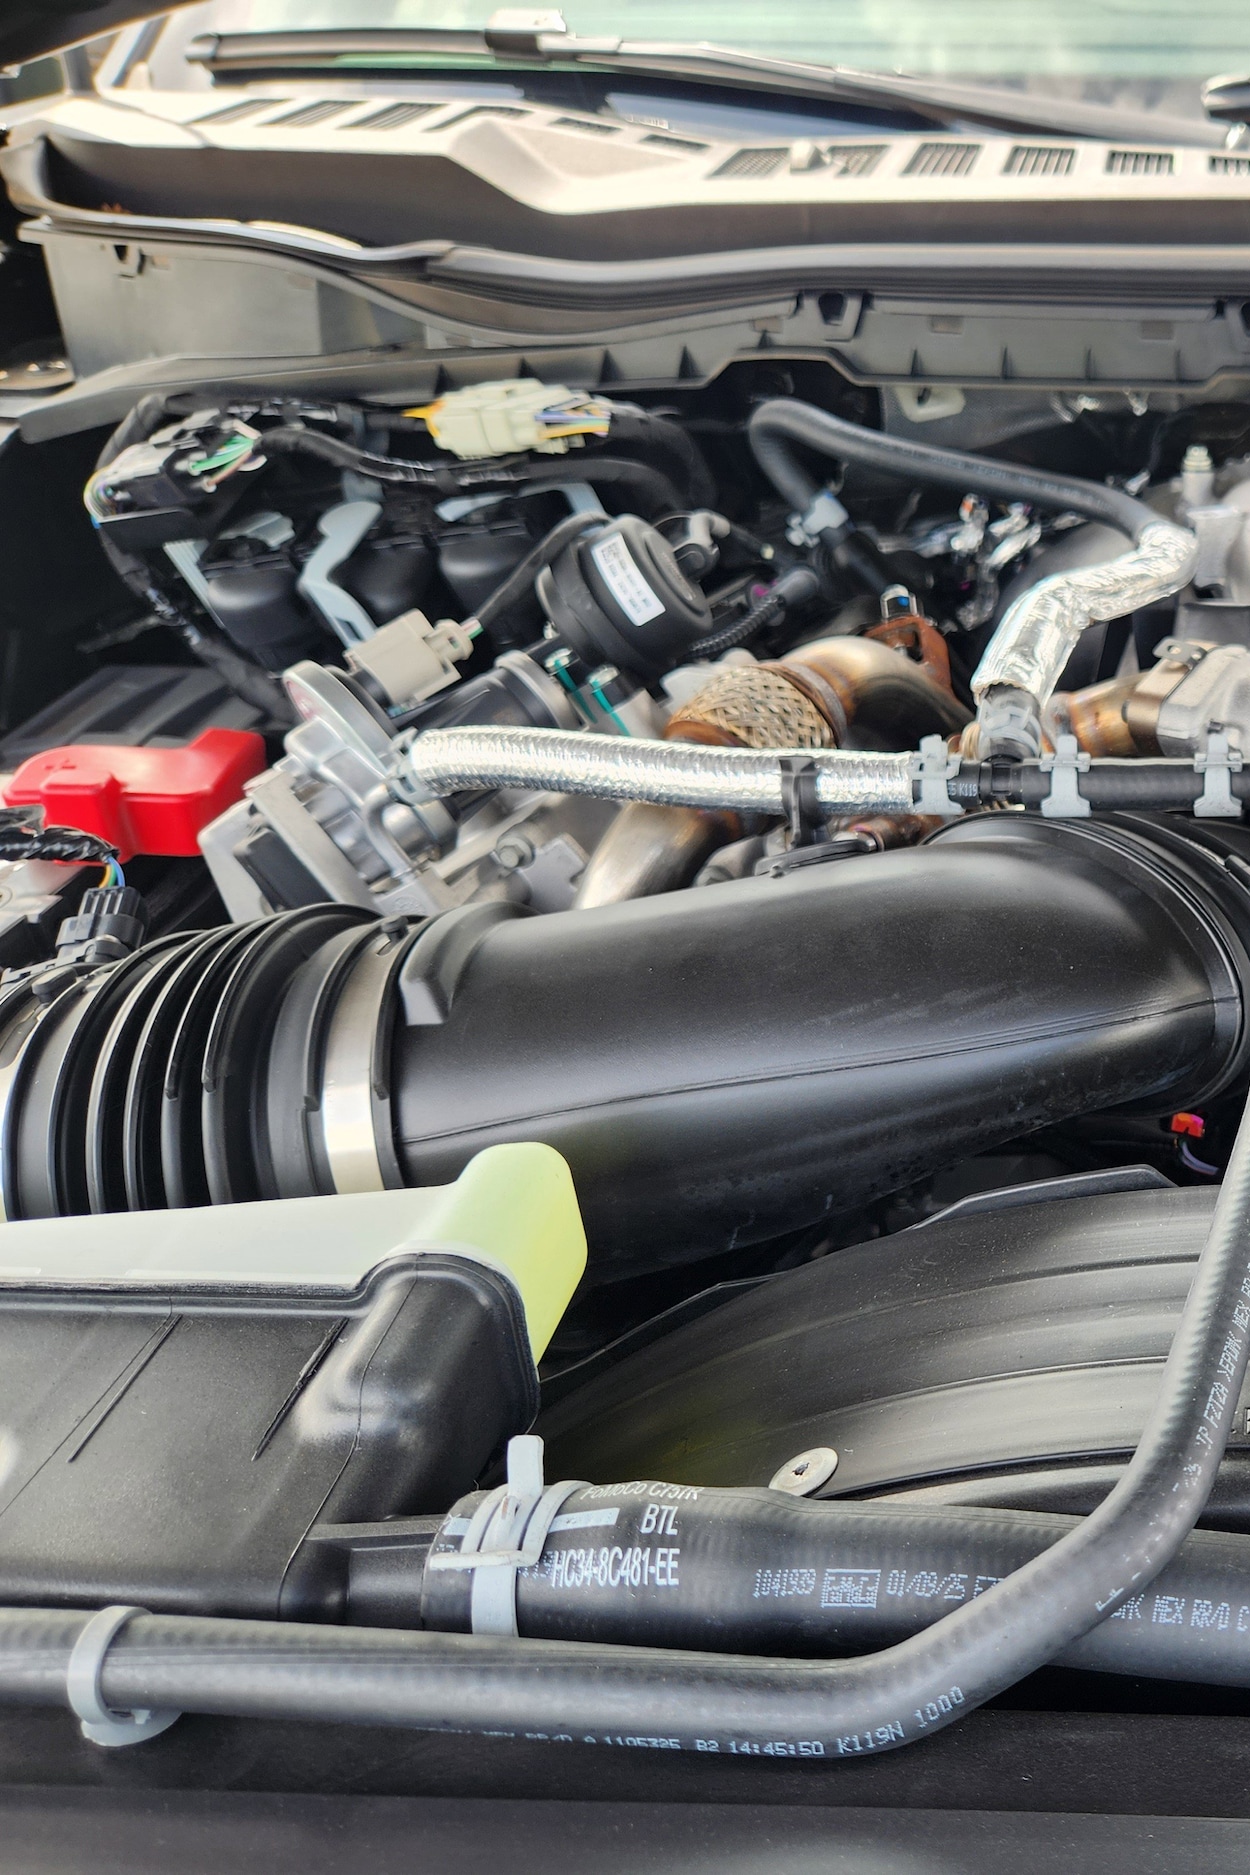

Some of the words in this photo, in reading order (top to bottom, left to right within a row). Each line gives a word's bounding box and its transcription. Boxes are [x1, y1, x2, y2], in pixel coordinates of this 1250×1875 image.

[1232, 1300, 1250, 1333] MEX
[579, 1480, 647, 1500] FoMoCo
[640, 1504, 679, 1535] BTL
[551, 1547, 680, 1588] HC34-8C481-EE
[886, 1570, 968, 1599] 01/09/25
[1152, 1594, 1185, 1624] MEX
[1190, 1599, 1230, 1631] RR/D
[1236, 1605, 1250, 1632] C
[695, 1739, 720, 1753] B2
[729, 1740, 825, 1756] 14:45:50
[837, 1720, 904, 1754] K119N
[914, 1685, 965, 1728] 1000
